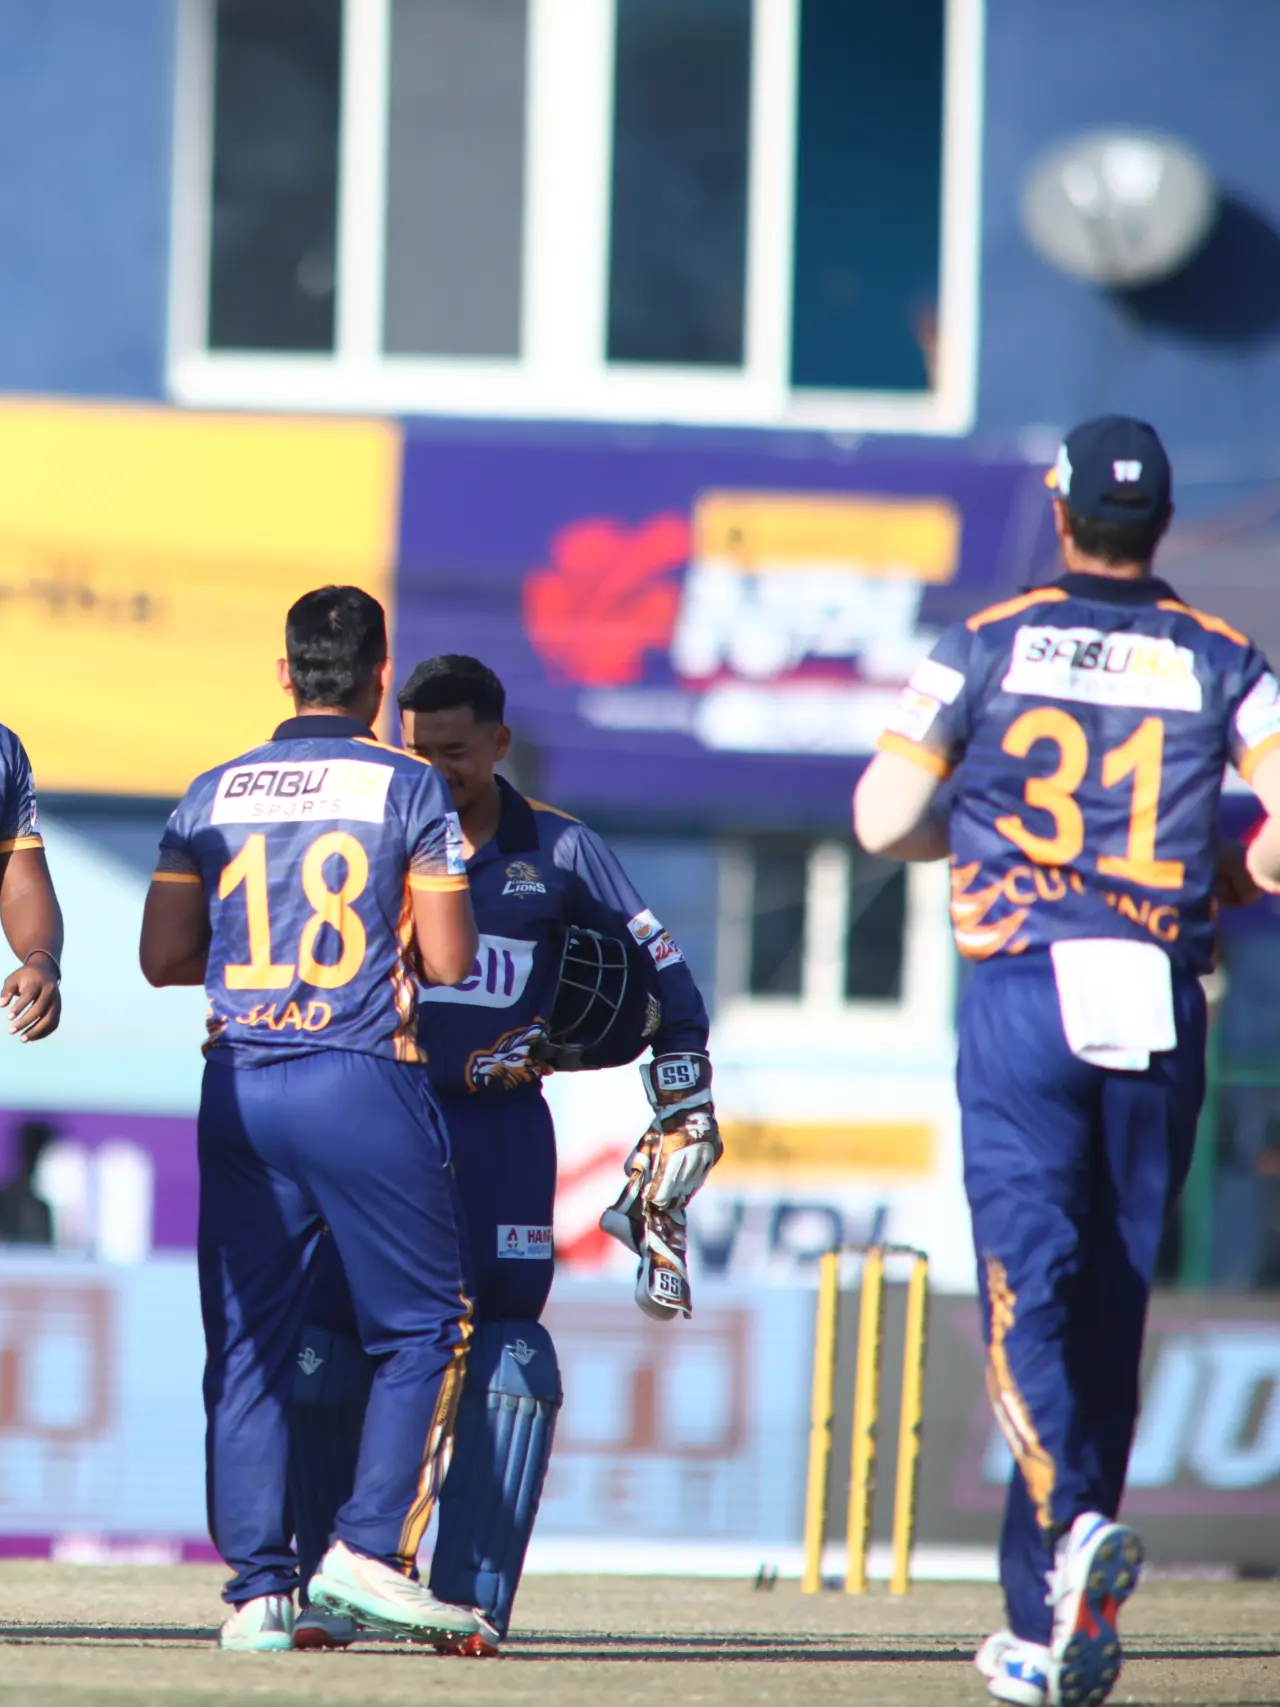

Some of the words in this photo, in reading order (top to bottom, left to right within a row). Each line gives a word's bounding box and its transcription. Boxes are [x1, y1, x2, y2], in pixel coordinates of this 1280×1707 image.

[224, 766, 384, 799] BABU88
[995, 707, 1186, 890] 31
[218, 830, 370, 989] 18
[662, 1064, 690, 1086] SS
[659, 1271, 680, 1296] SS
